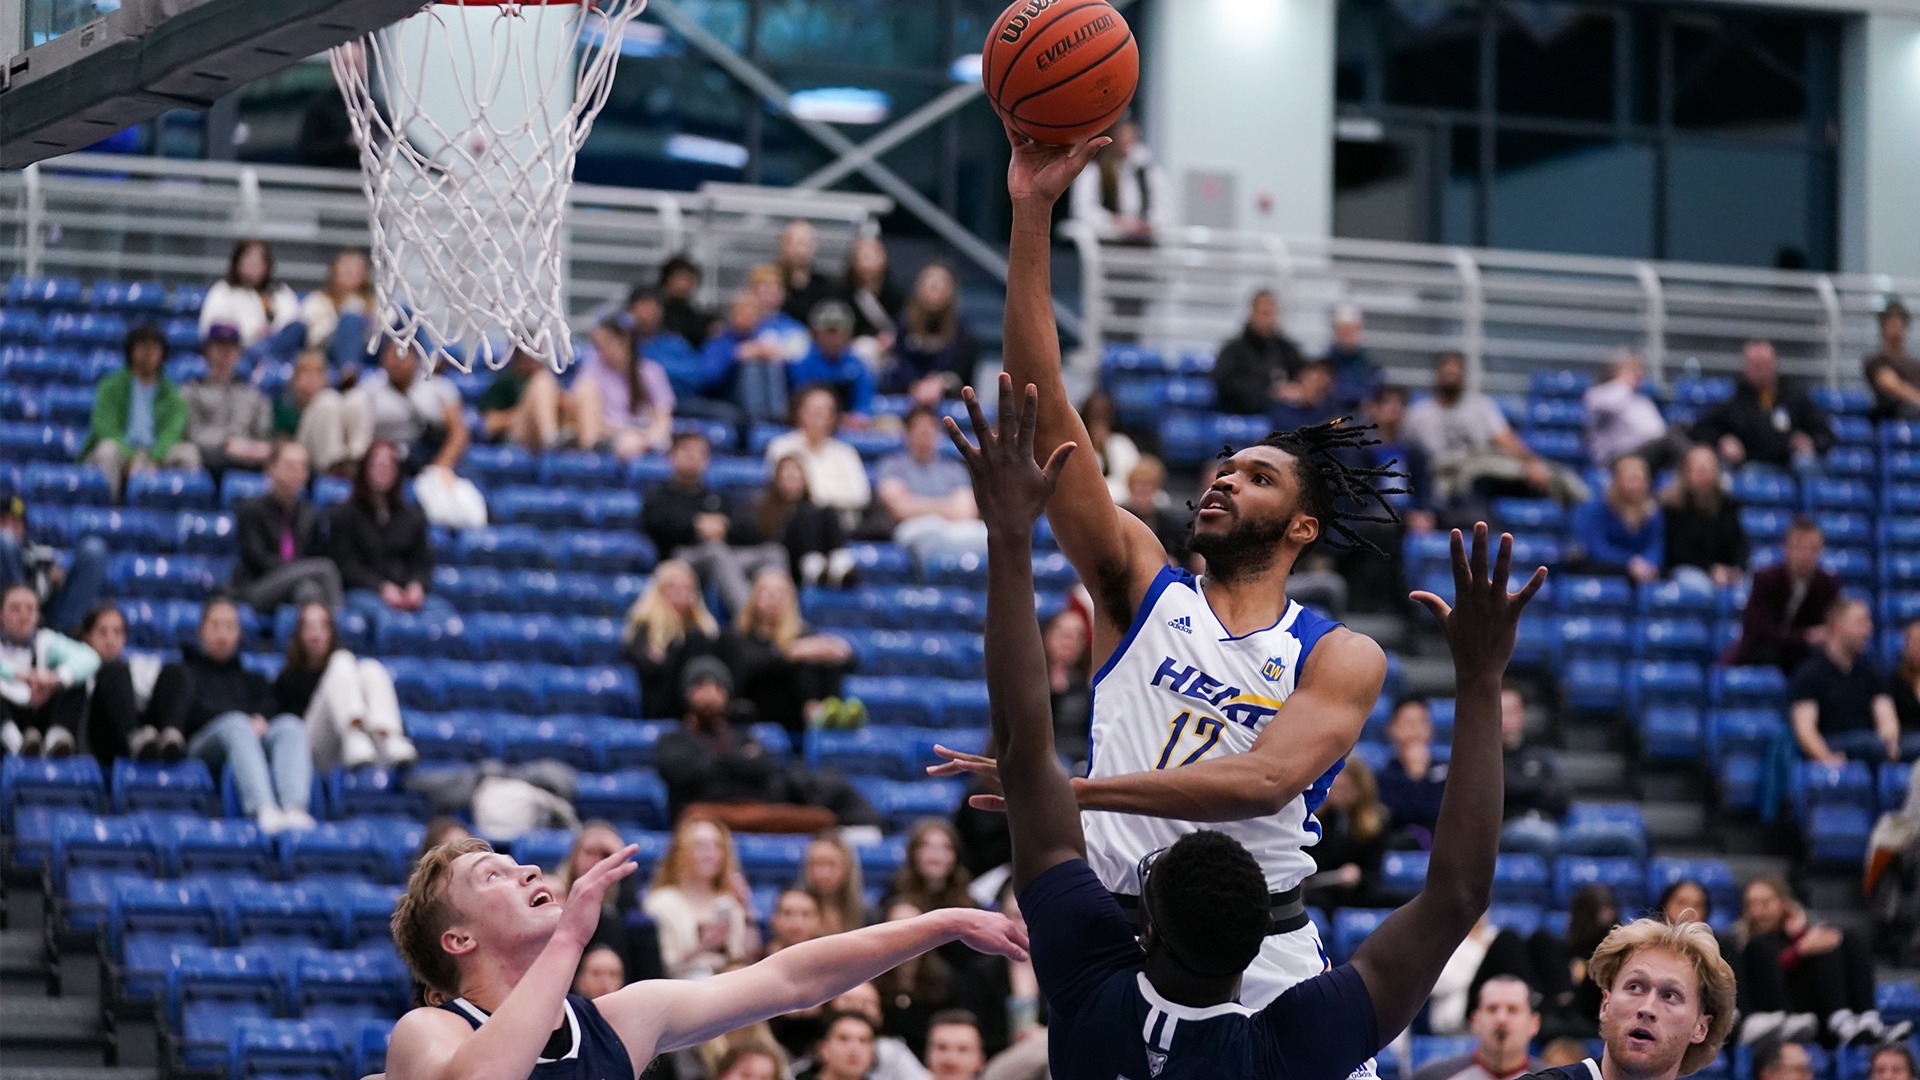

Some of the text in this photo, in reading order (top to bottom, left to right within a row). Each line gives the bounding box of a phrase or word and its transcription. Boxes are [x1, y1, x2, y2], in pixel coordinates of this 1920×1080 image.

[1036, 13, 1114, 70] EVOLUTION
[1167, 620, 1193, 635] adidas
[1150, 656, 1279, 730] HEAT
[1153, 709, 1228, 770] 12
